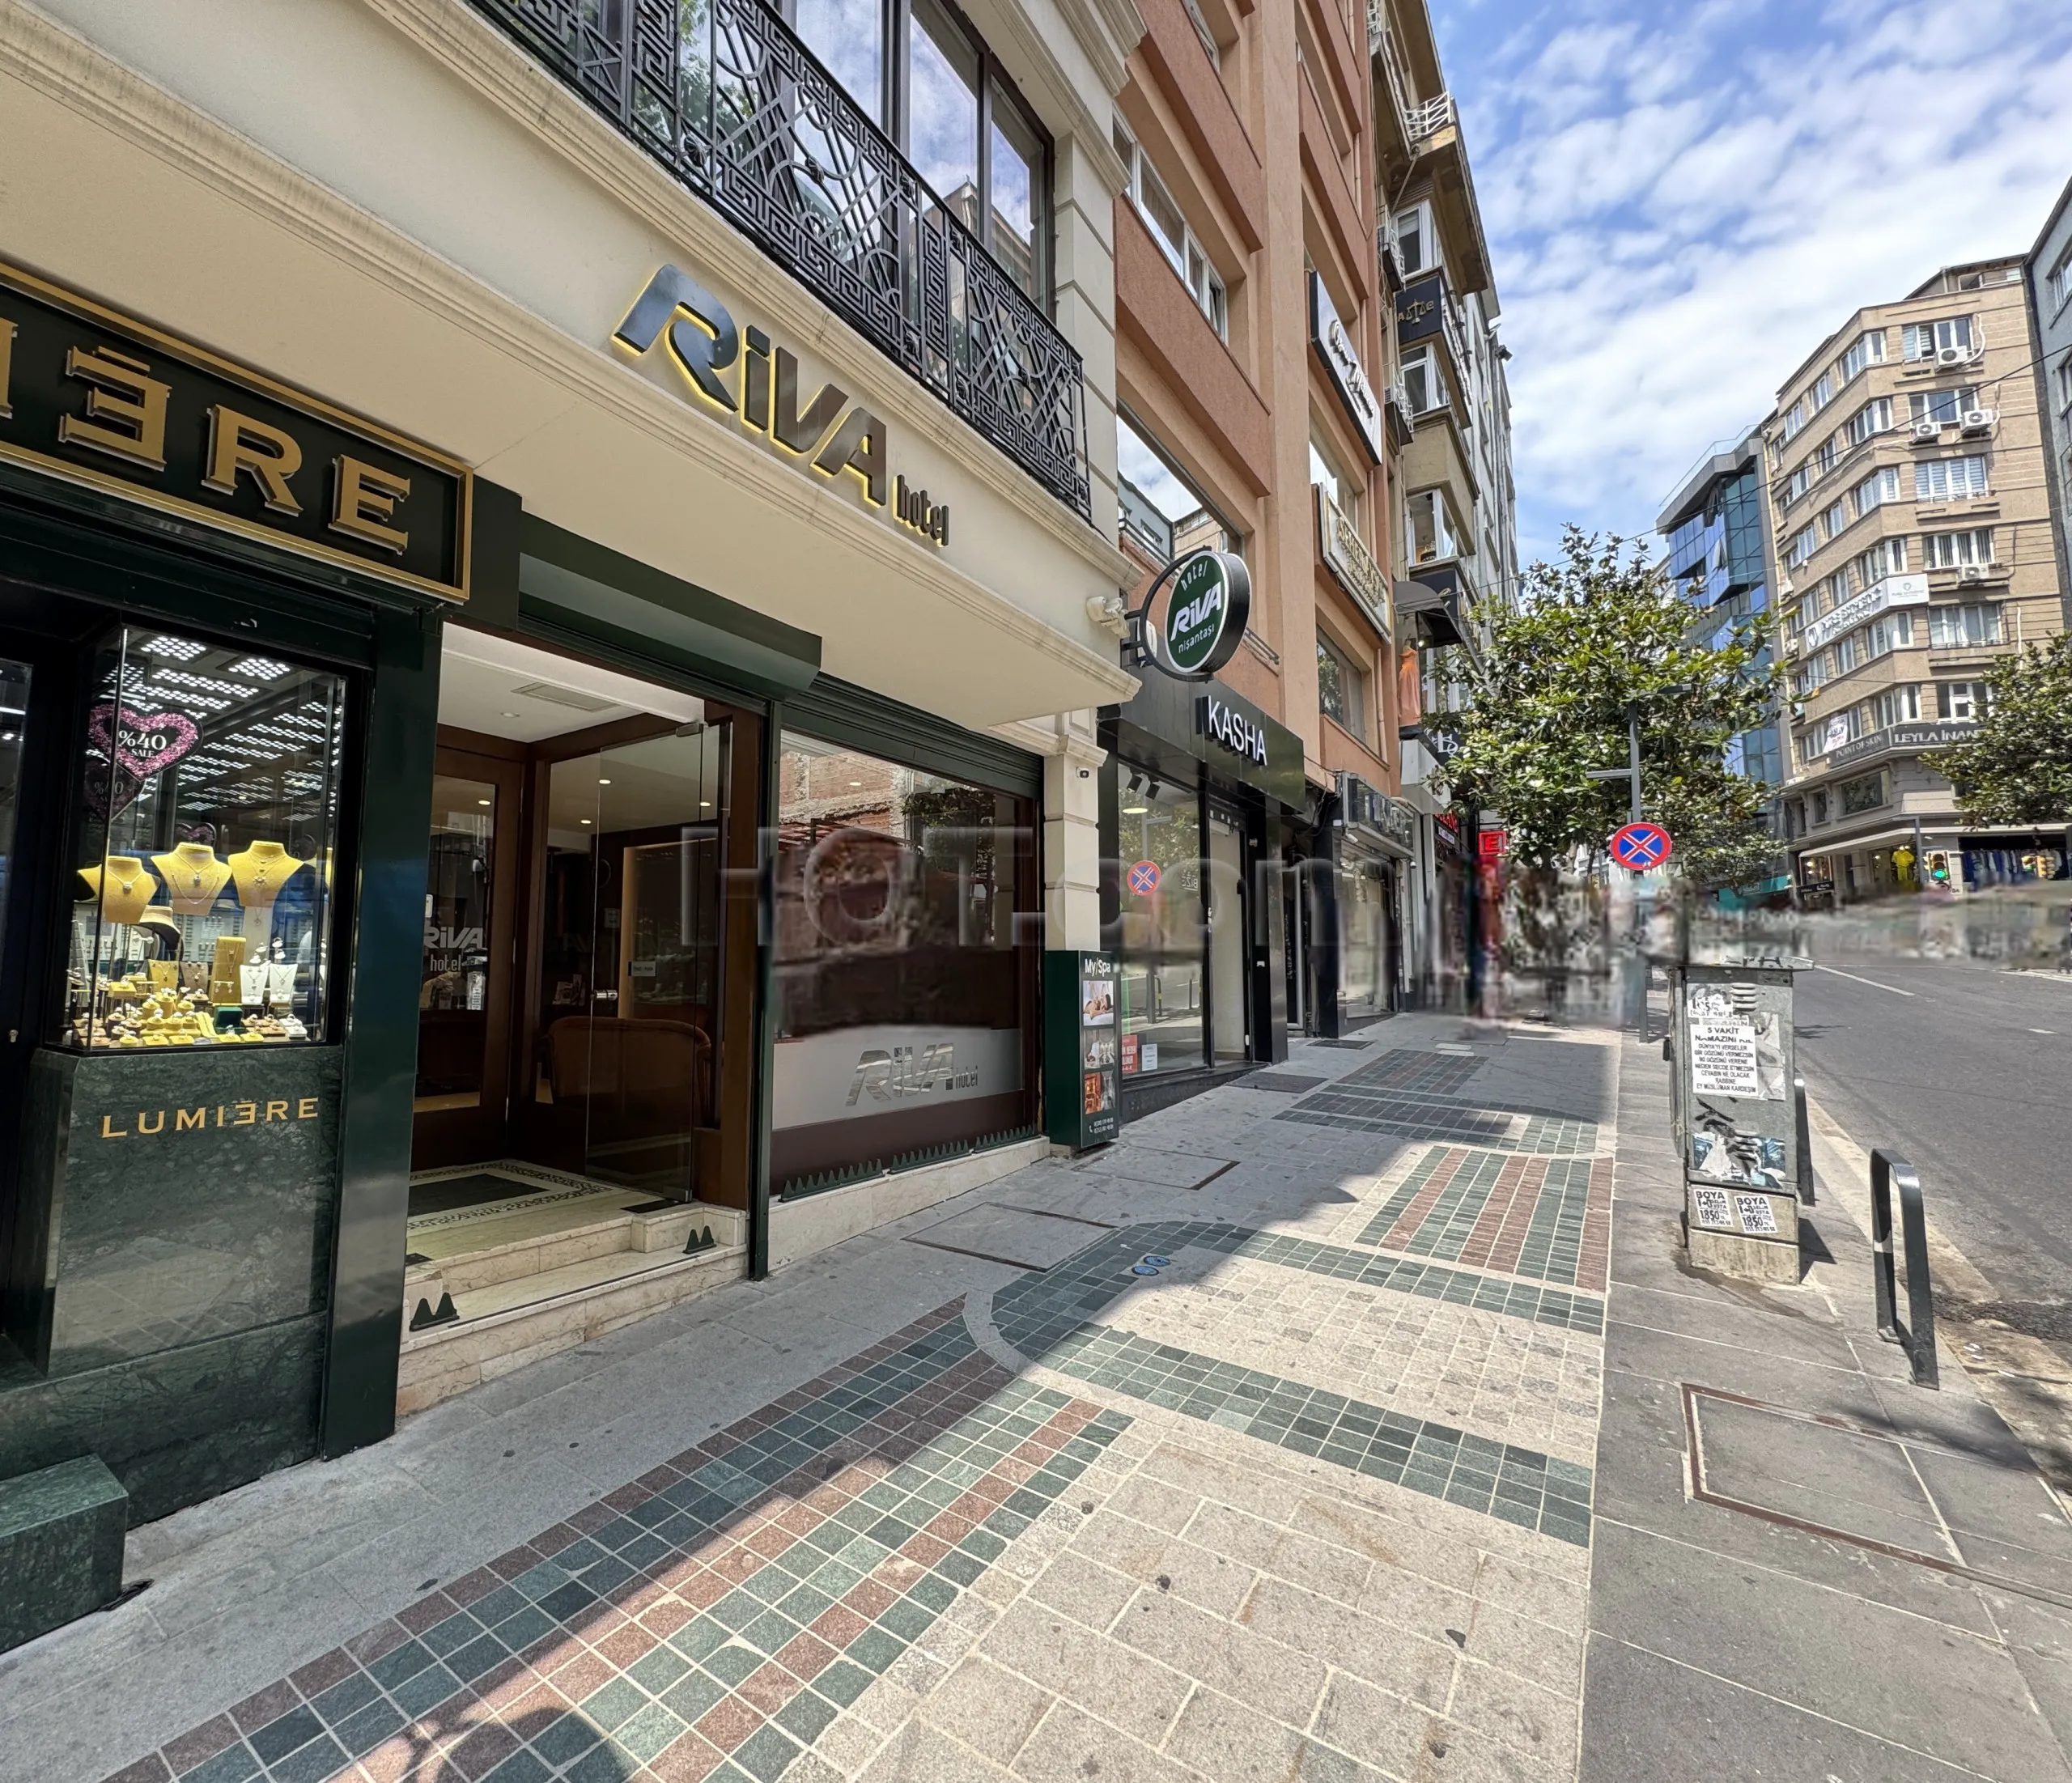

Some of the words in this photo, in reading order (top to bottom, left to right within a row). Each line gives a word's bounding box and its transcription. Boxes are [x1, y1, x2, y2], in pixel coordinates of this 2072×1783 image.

[893, 474, 949, 547] hotel
[1180, 560, 1208, 592] hotel
[1178, 623, 1215, 654] nişantaşı
[1208, 694, 1267, 766] KASHA
[119, 730, 167, 750] %40
[1894, 732, 1938, 744] LEYLA
[131, 749, 155, 758] SALE
[431, 954, 461, 971] hotel
[1714, 1026, 1740, 1035] VAKİT
[1696, 1191, 1725, 1199] BOYA
[1736, 1197, 1767, 1205] BOYA
[1700, 1209, 1720, 1221] 1850
[1742, 1216, 1764, 1228] 1850
